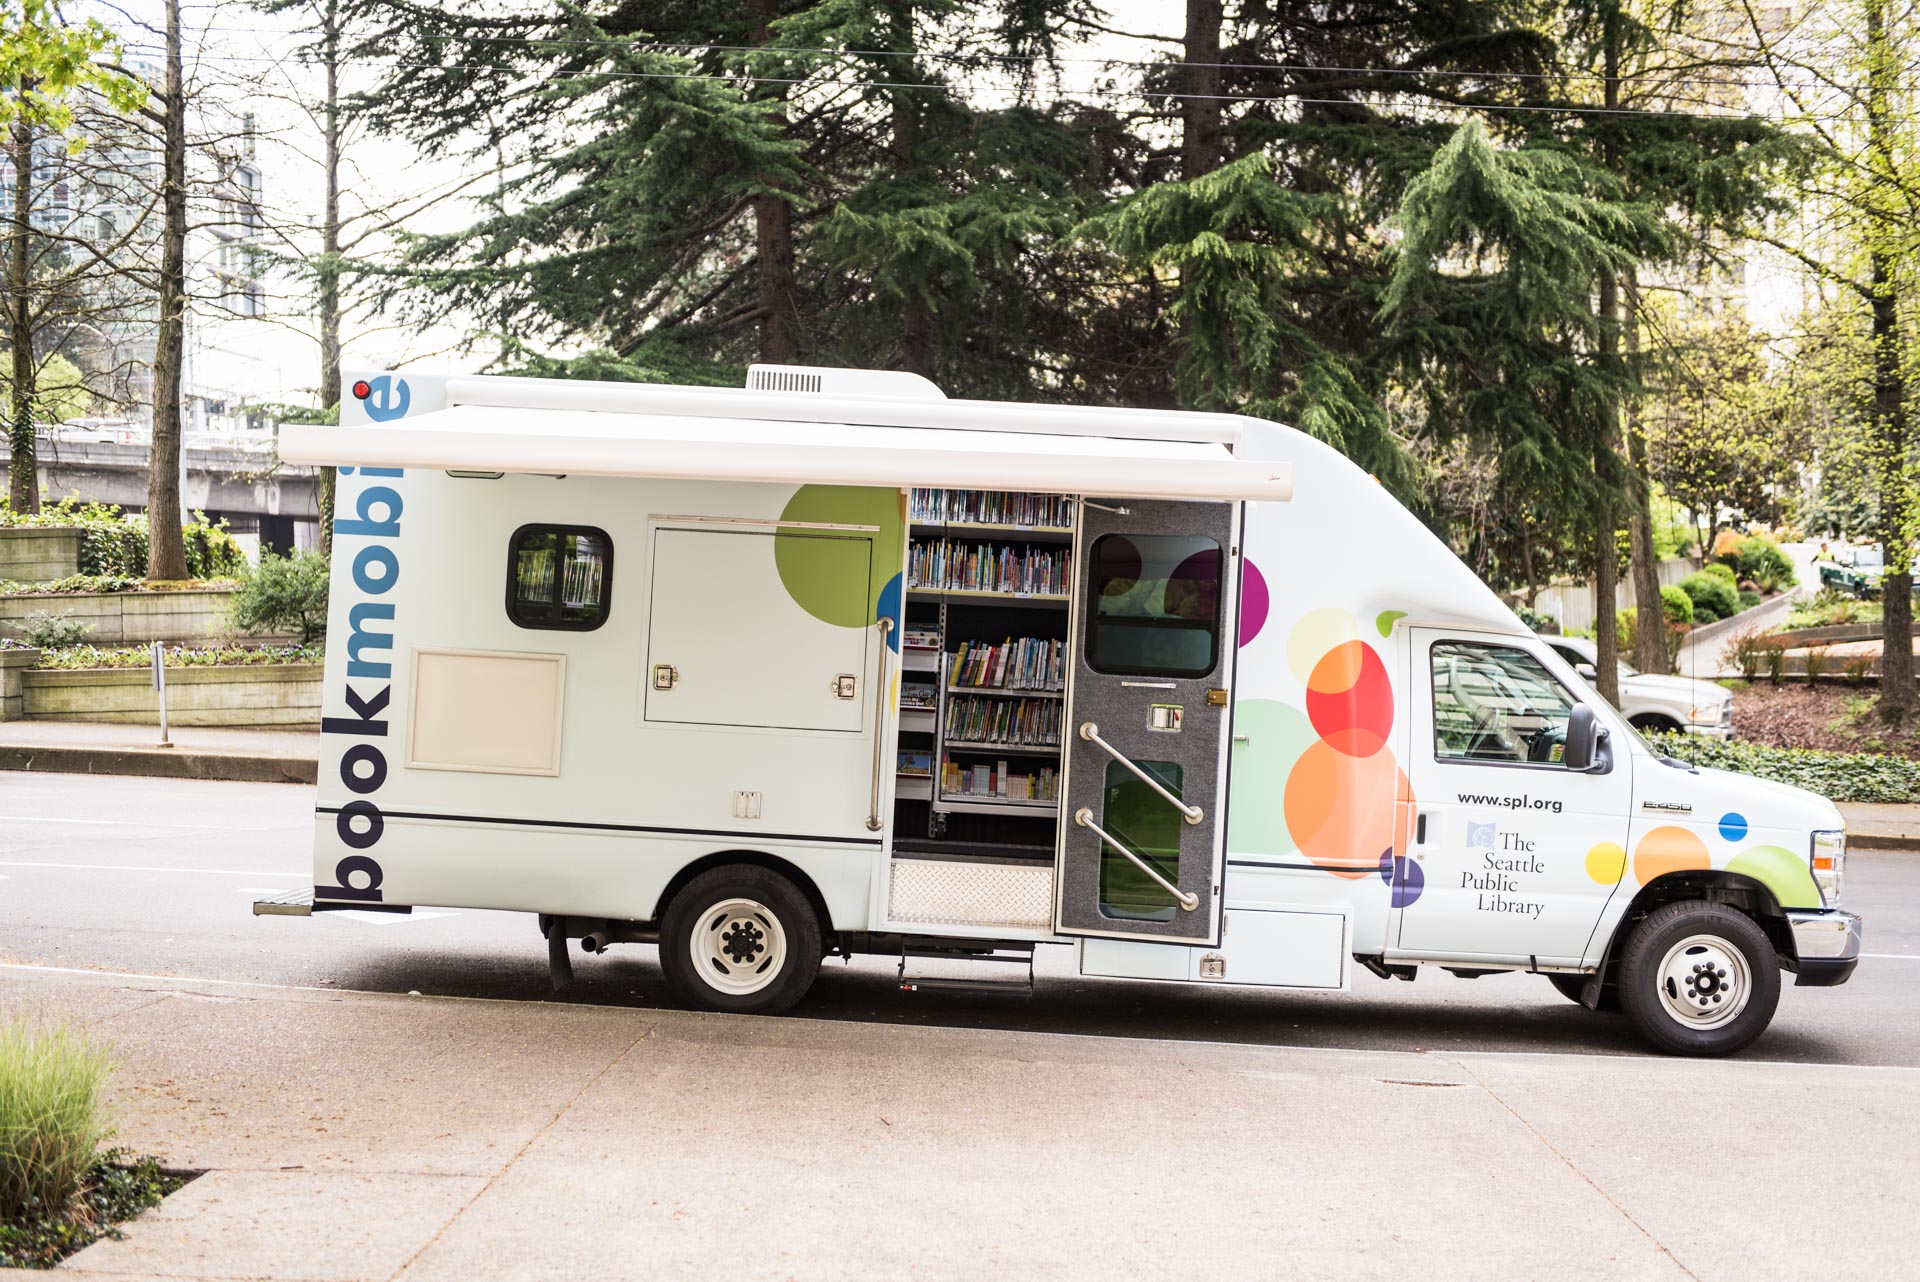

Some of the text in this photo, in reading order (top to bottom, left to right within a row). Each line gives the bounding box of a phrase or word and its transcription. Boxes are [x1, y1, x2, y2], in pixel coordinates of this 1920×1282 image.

[314, 375, 411, 902] bookmobie
[1458, 792, 1563, 813] www.spl.org
[1500, 832, 1535, 851] The
[1483, 852, 1545, 874] Seattle
[1461, 872, 1518, 892] Public
[1478, 894, 1545, 920] Library
